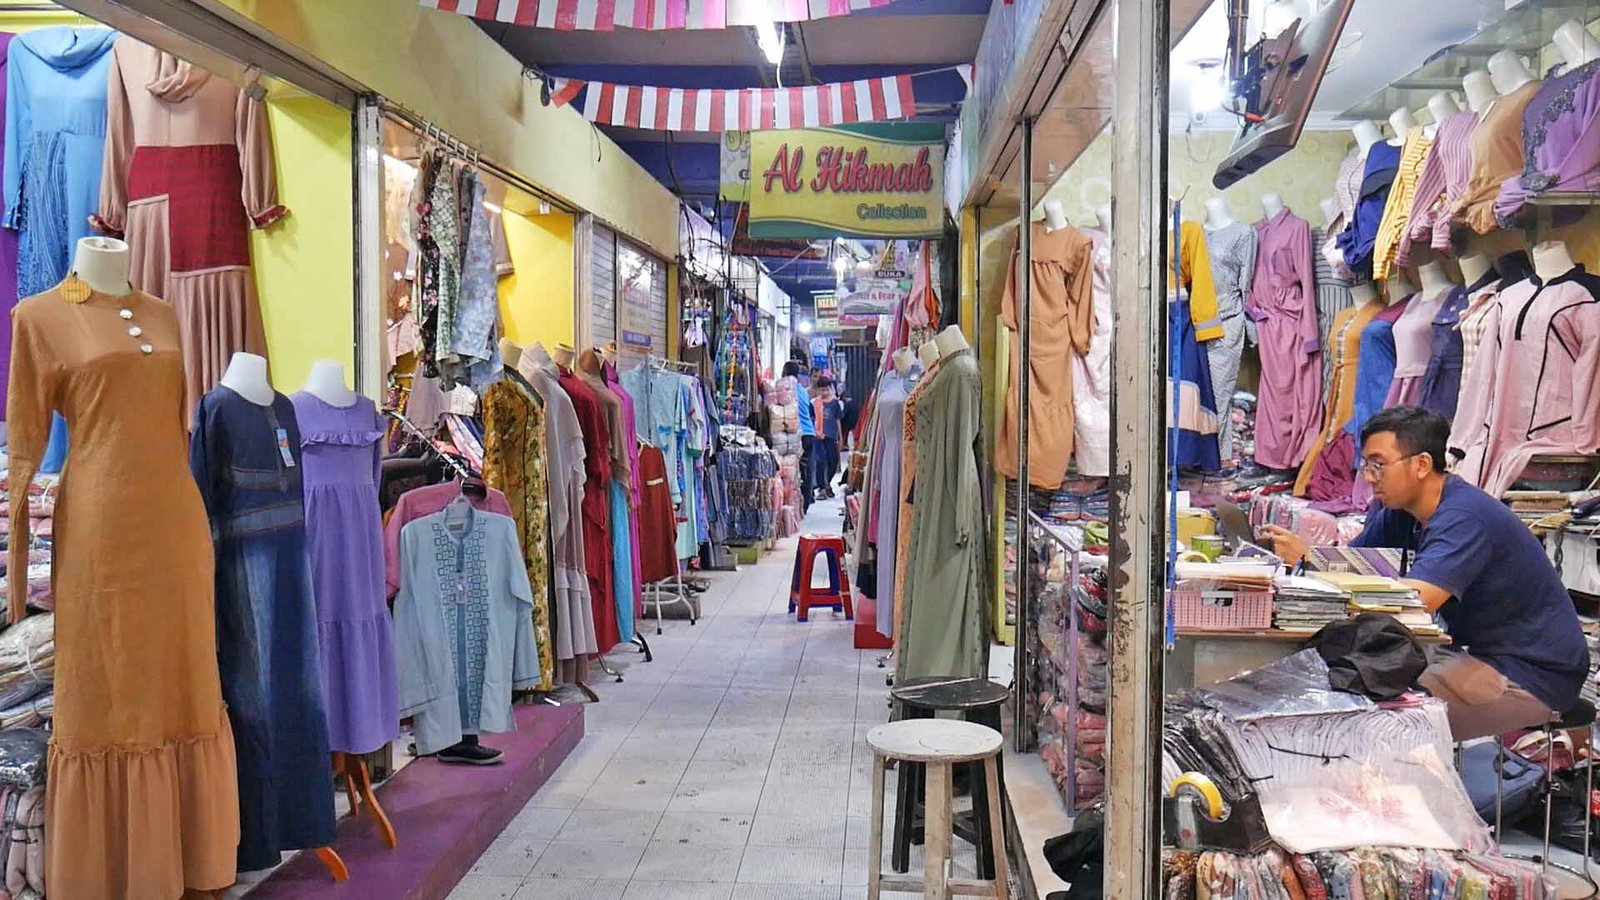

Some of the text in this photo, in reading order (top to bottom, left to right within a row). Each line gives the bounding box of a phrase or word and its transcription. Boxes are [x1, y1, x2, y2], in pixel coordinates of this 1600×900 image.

[762, 143, 933, 193] Al Hikmah
[856, 202, 927, 219] Collection
